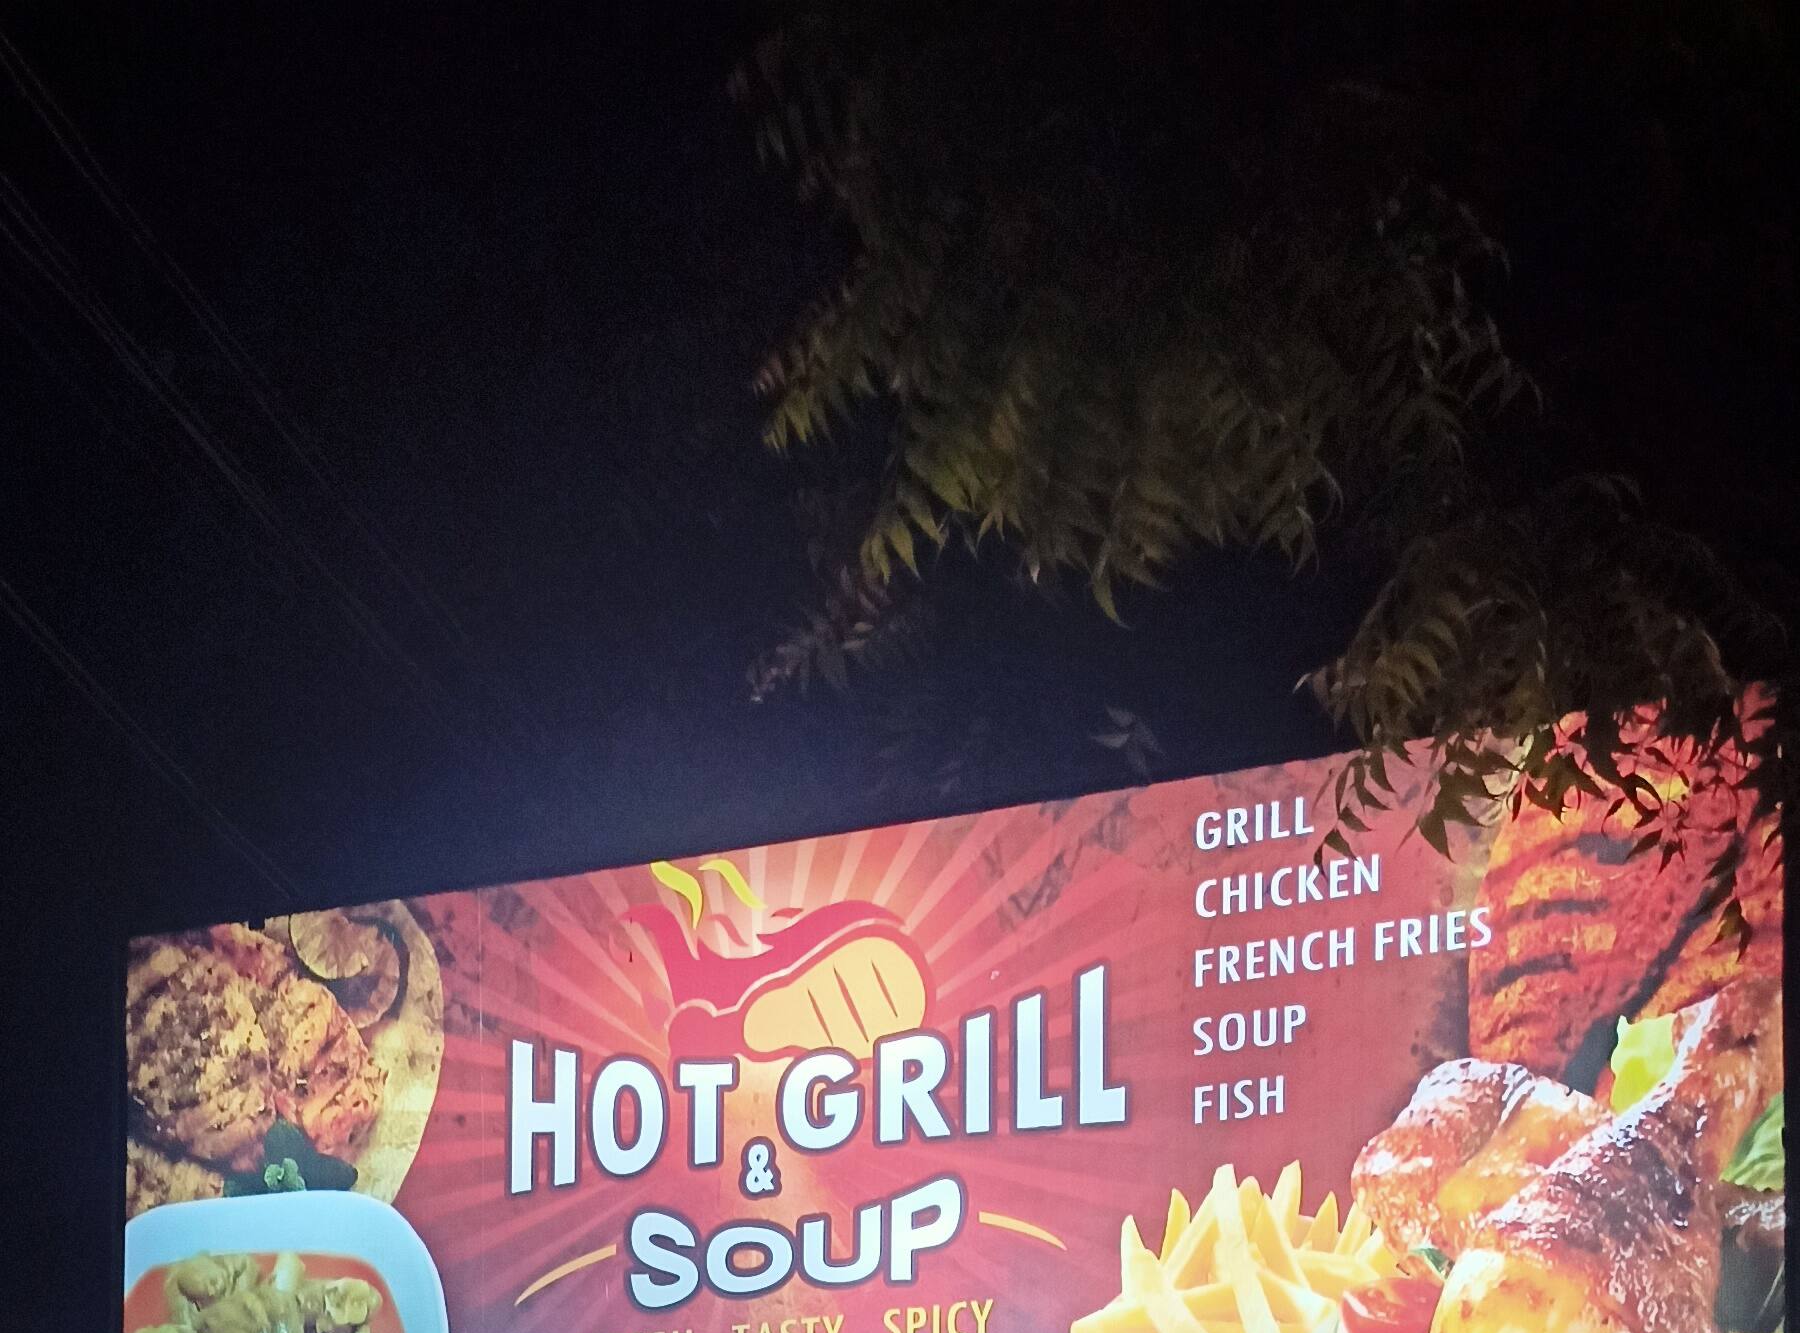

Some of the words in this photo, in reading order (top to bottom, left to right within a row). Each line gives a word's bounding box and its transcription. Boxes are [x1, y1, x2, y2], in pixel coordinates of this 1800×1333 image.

[1195, 796, 1315, 850] GRILL
[1195, 854, 1380, 918] CHICKEN
[1194, 926, 1355, 988] FRENCH
[1374, 906, 1493, 962] FRIES
[1192, 1004, 1307, 1056] SOUP
[508, 1039, 738, 1194] HOT
[780, 964, 1127, 1152] GRILL
[1194, 1075, 1285, 1124] FISH
[743, 1142, 778, 1194] &
[629, 1177, 963, 1309] SOUP
